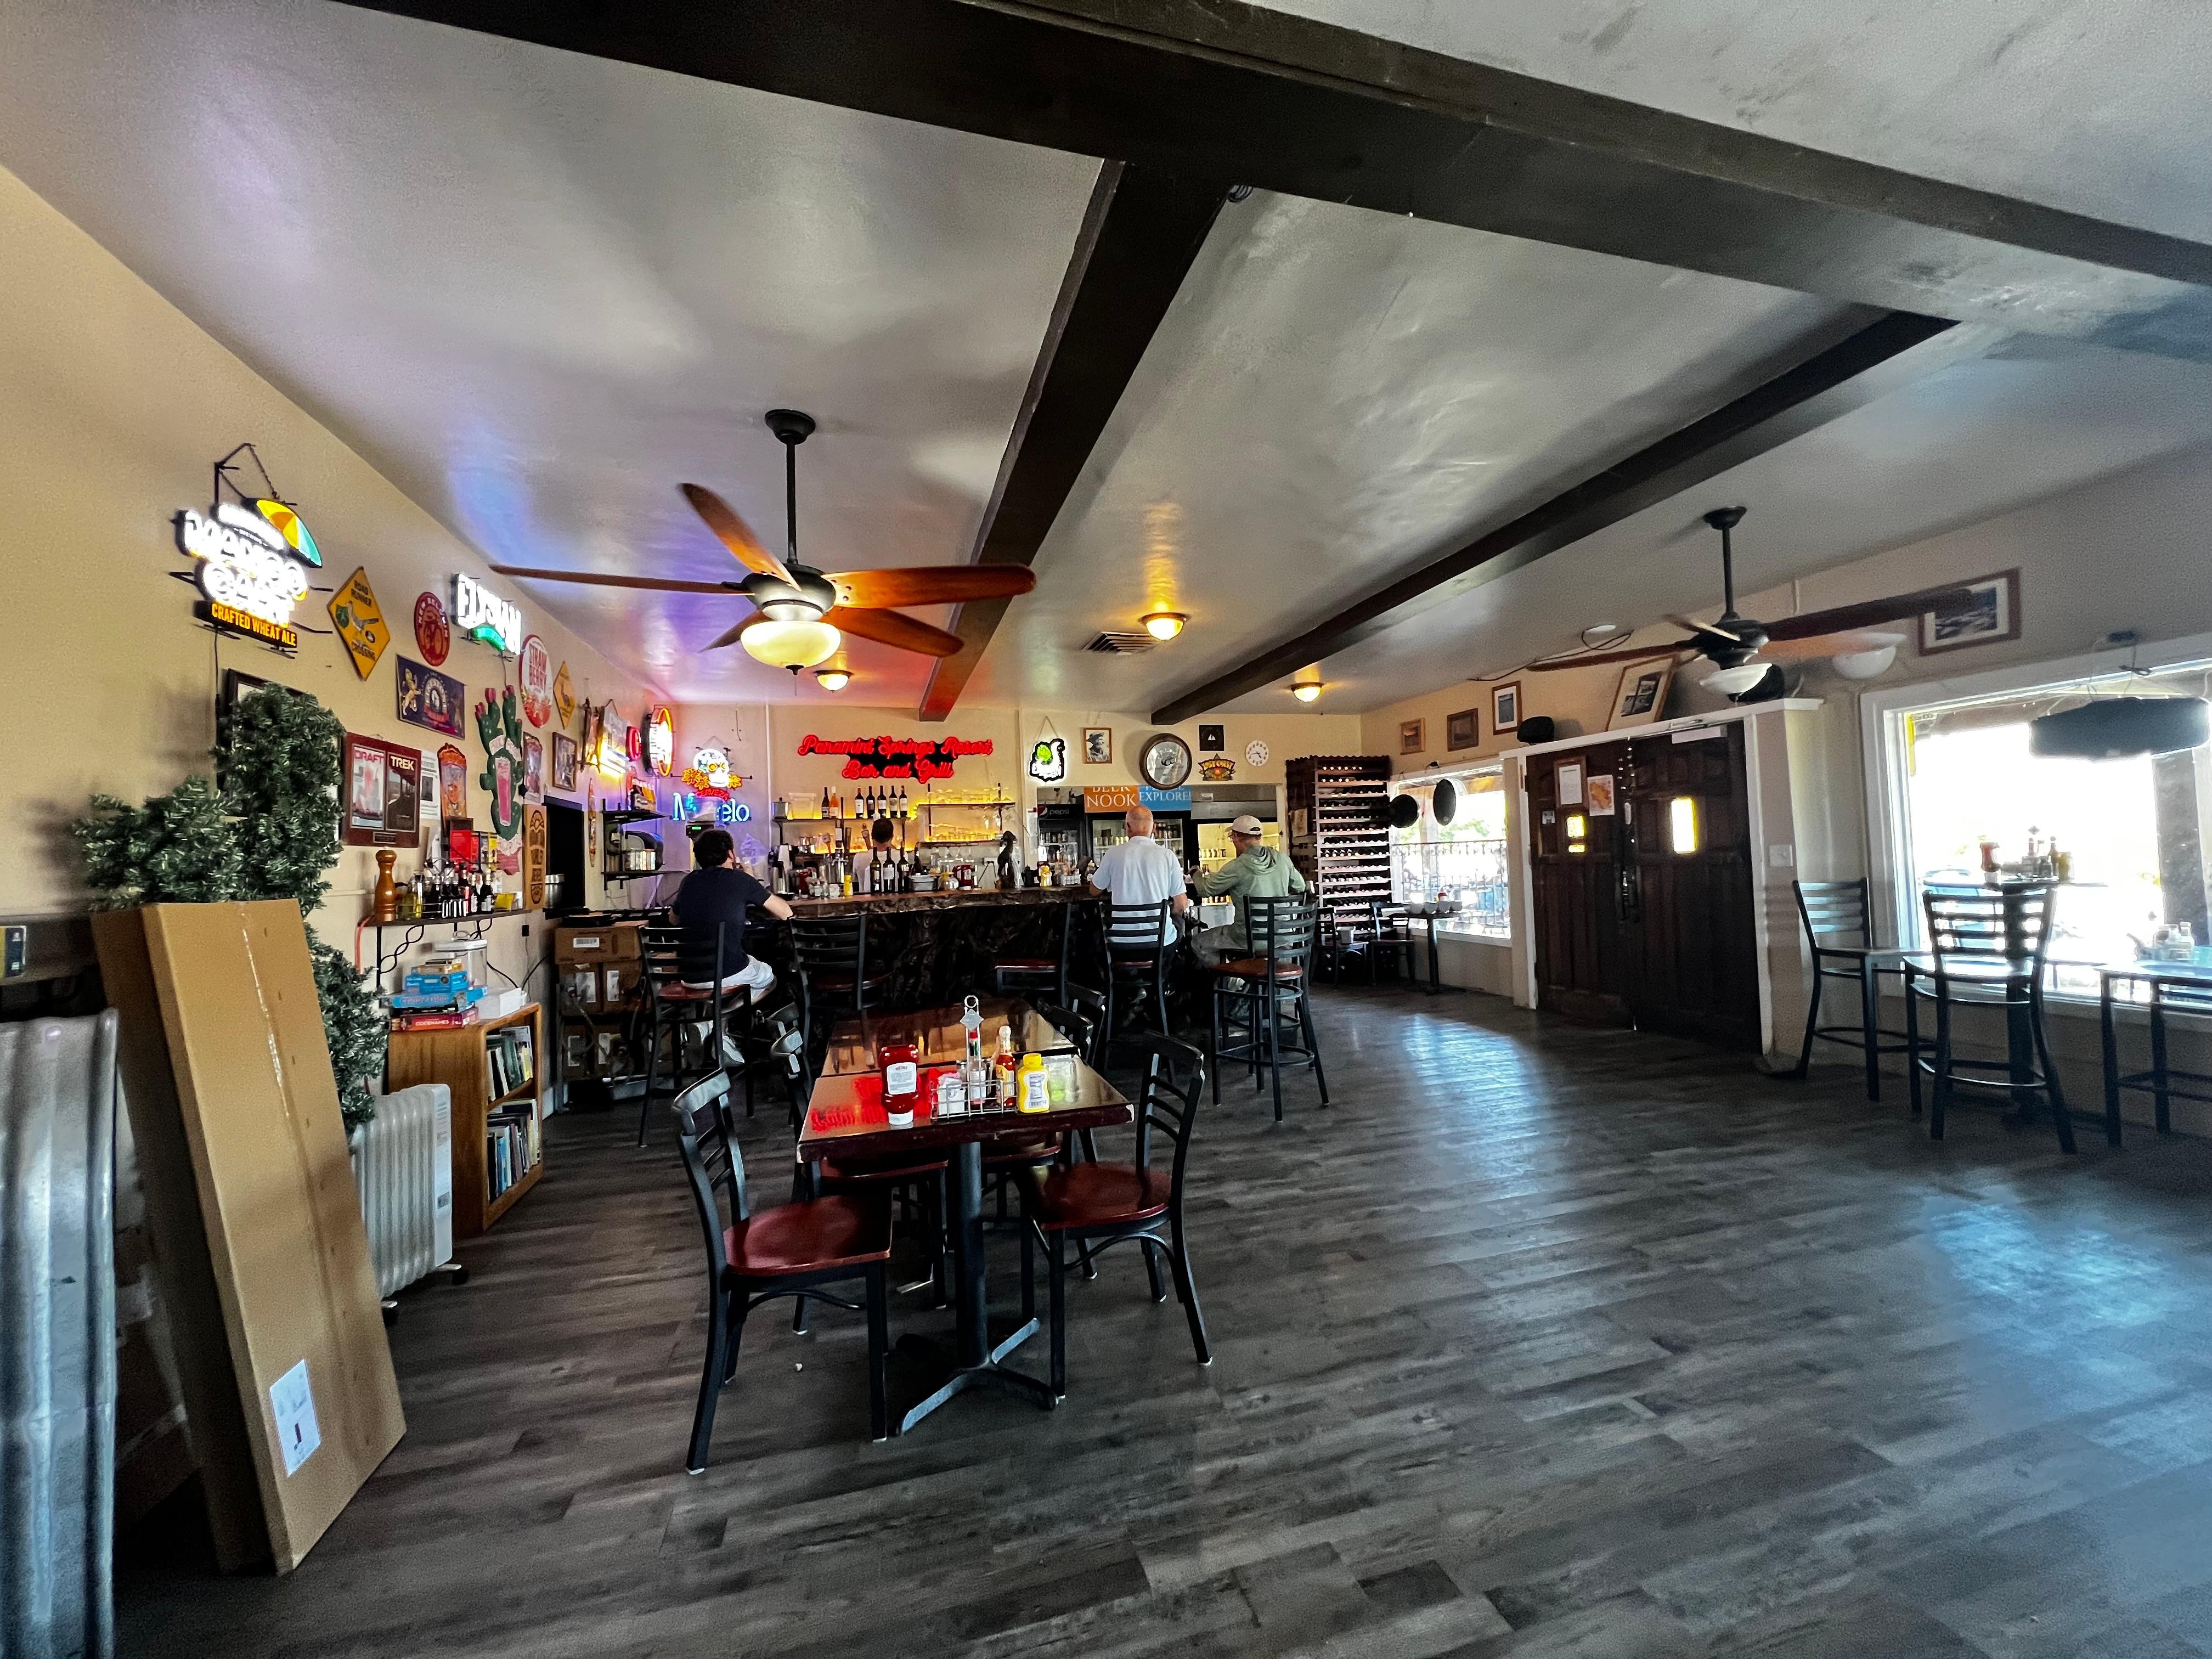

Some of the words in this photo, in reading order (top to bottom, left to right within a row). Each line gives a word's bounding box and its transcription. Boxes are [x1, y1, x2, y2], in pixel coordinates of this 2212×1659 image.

[351, 588, 372, 608] RUNNER
[457, 573, 522, 656] ELYSIAN
[211, 603, 251, 630] CRAFTED
[252, 619, 280, 640] WHEAT
[281, 630, 296, 647] ALE
[355, 750, 384, 764] DRAFT
[797, 734, 876, 756] Panamint
[878, 735, 936, 760] Springs
[940, 736, 994, 759] Resort
[390, 755, 415, 771] TREK
[842, 759, 879, 780] Bar
[882, 761, 912, 778] and
[914, 758, 955, 785] Grill
[1086, 793, 1137, 808] NOOK
[1049, 808, 1070, 816] pepsi
